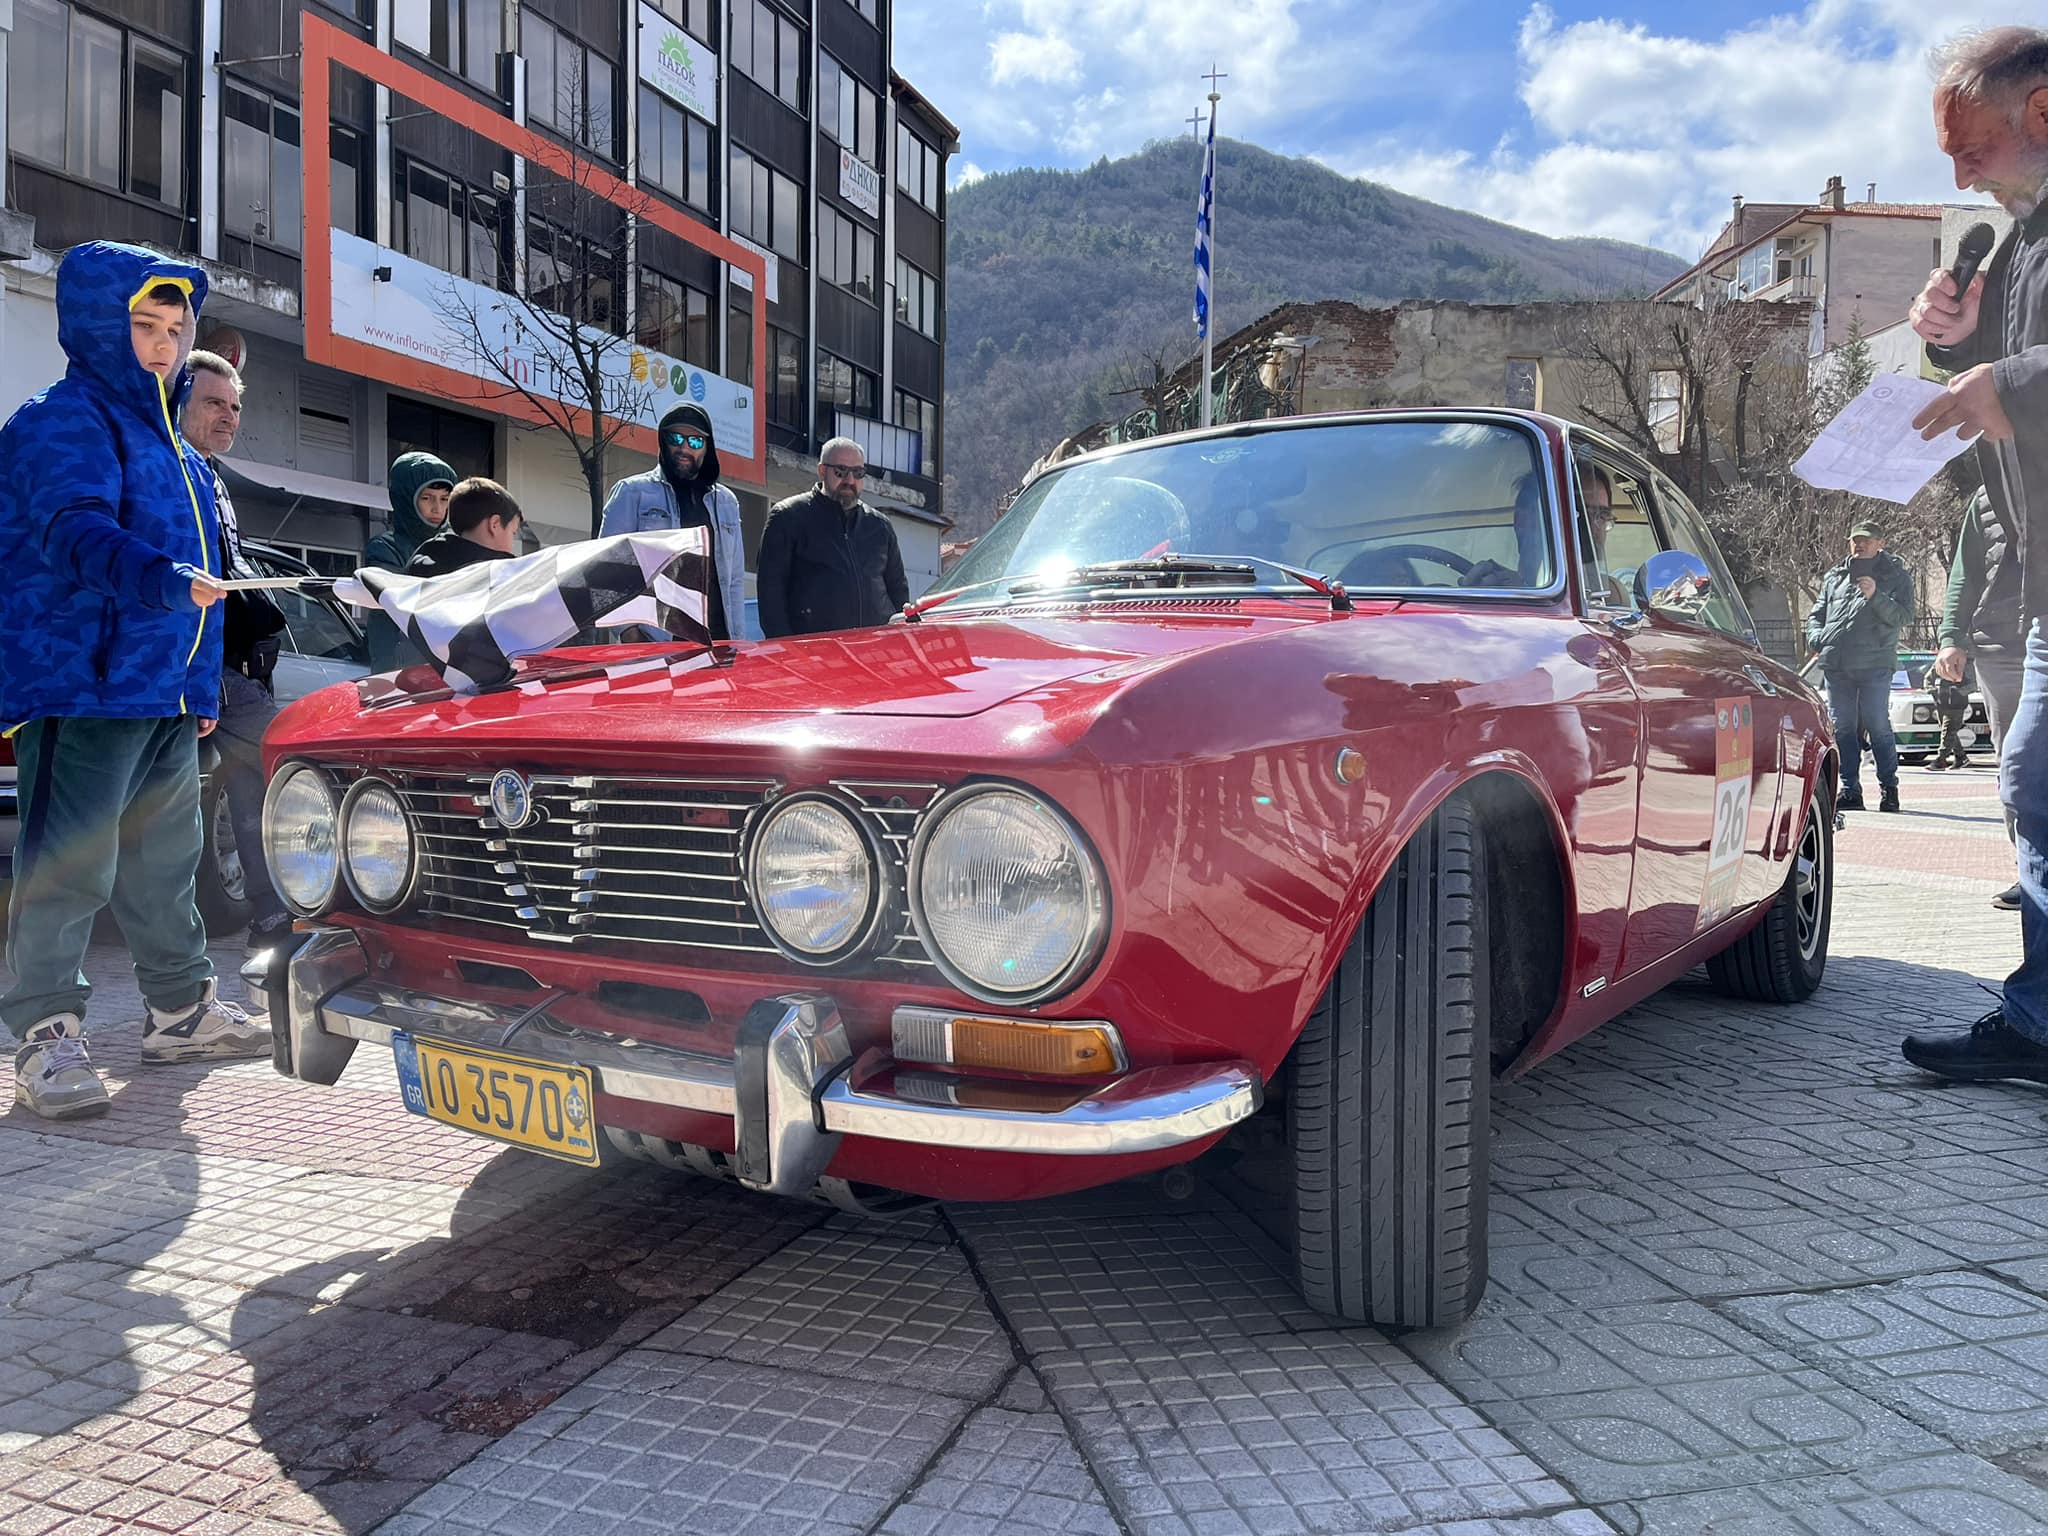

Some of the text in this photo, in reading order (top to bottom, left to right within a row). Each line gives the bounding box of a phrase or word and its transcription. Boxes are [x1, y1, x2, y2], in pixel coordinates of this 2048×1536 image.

[658, 50, 695, 87] ΠΑΣΟΚ
[364, 325, 449, 362] www.inflorina.gr
[1714, 784, 1746, 859] 26
[406, 1083, 424, 1107] GR
[466, 1063, 564, 1142] 3570
